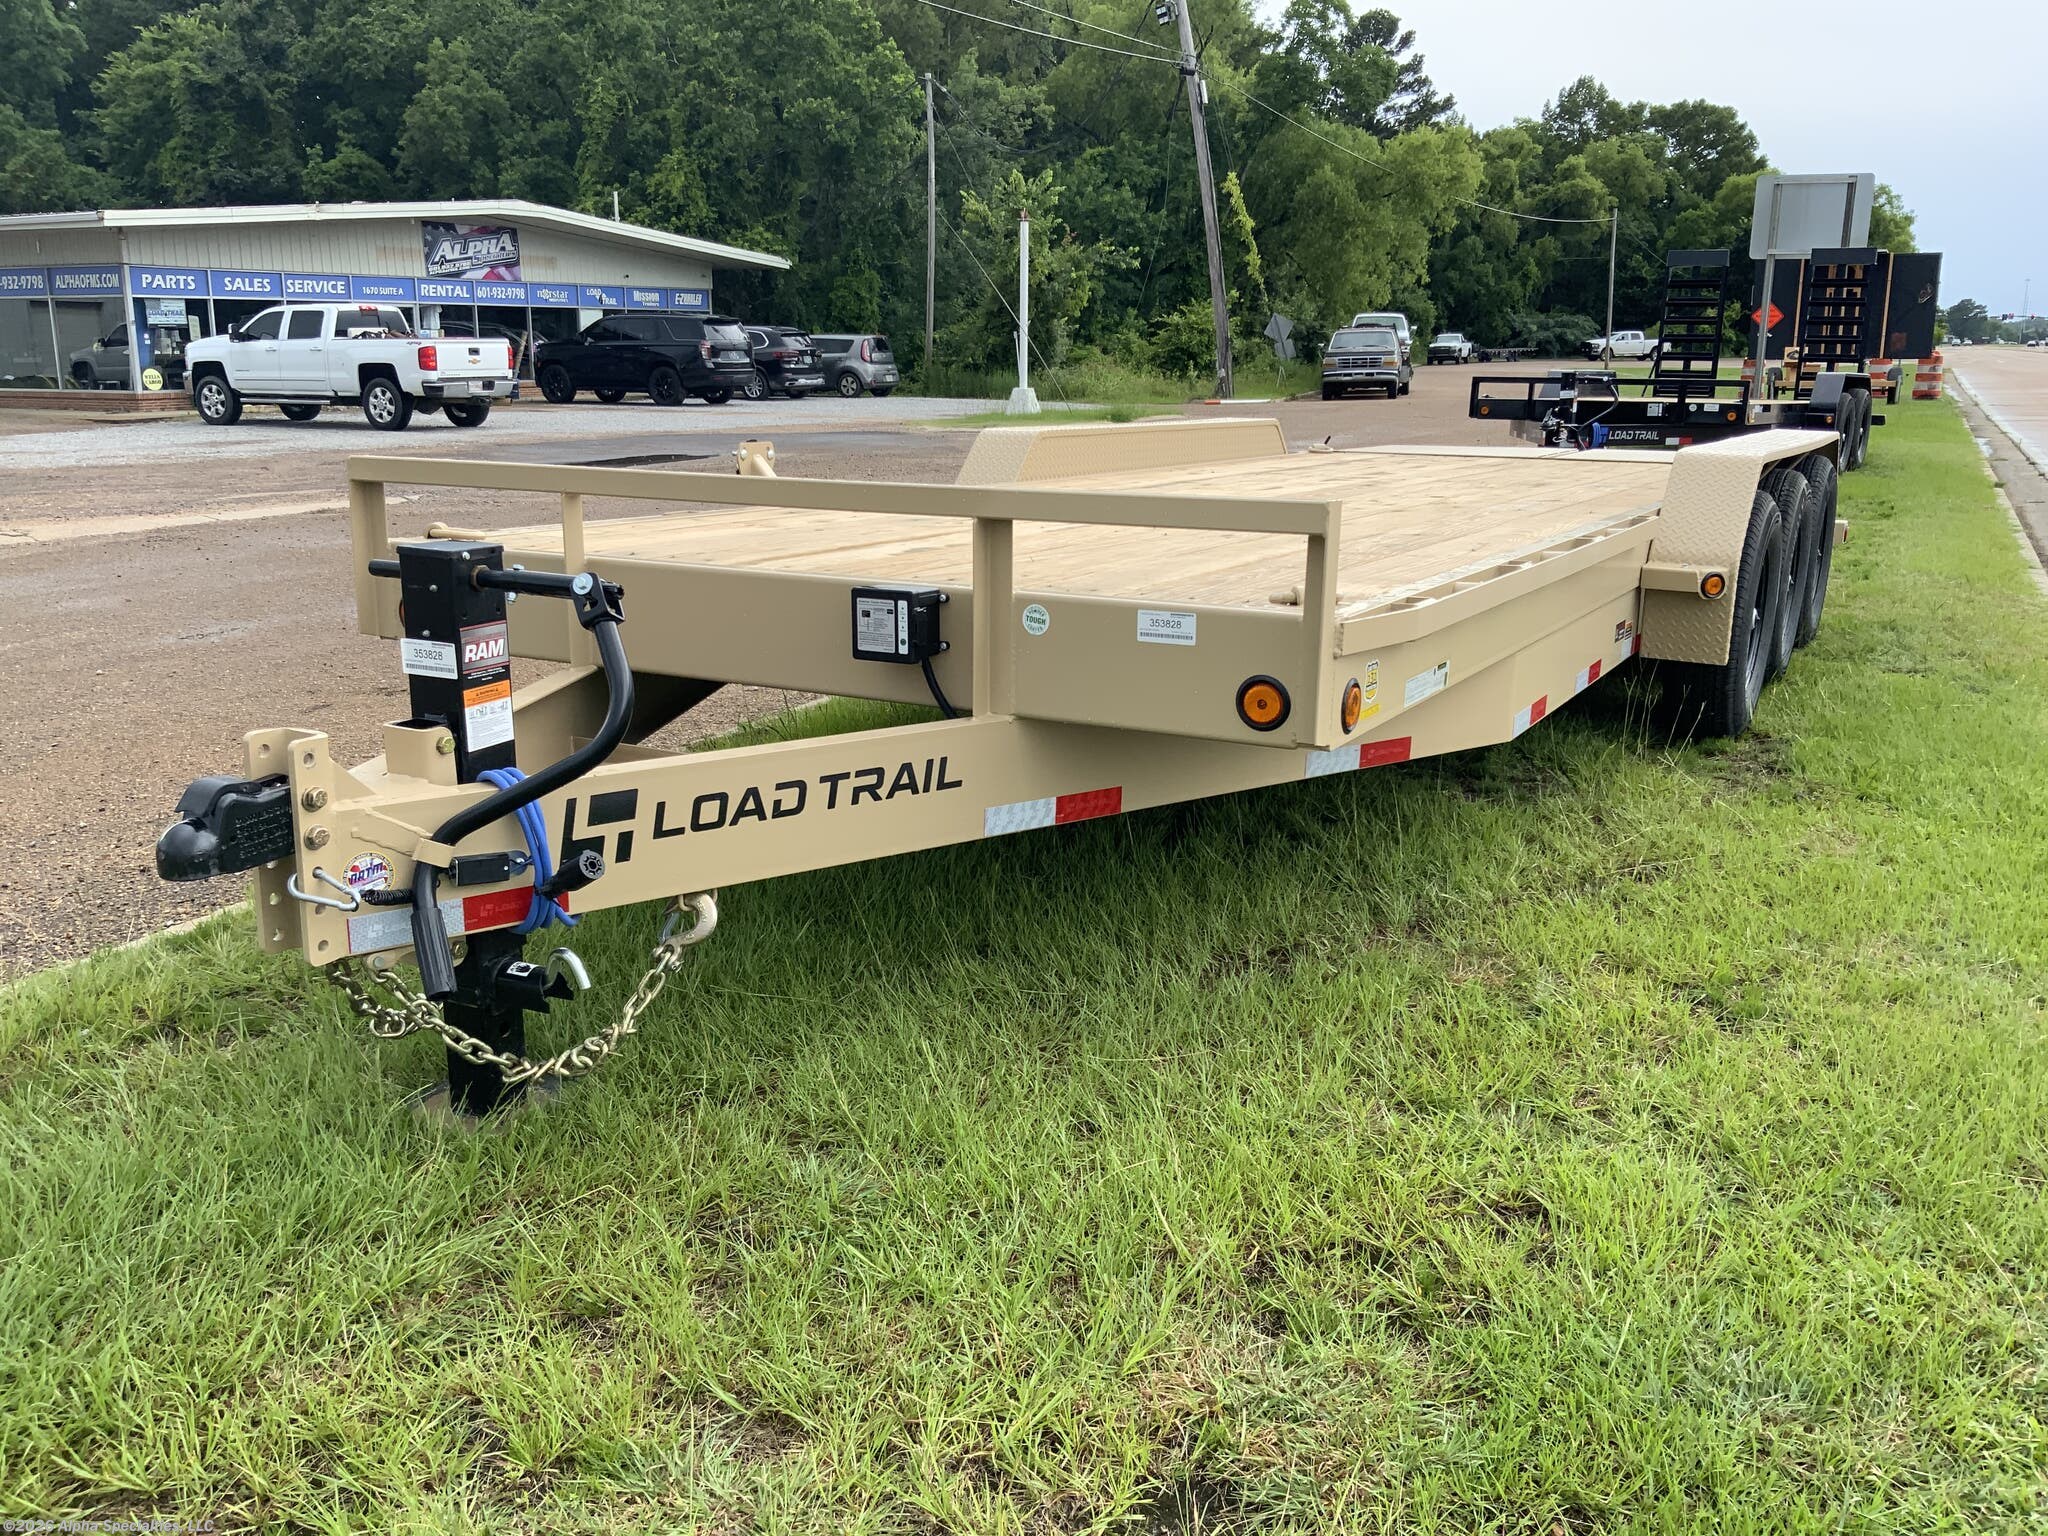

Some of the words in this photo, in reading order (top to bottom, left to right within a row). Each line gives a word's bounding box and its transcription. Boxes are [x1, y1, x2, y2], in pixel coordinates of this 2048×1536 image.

[431, 232, 516, 262] ALPHA
[55, 273, 120, 289] ALPHAOFMS.COM
[141, 273, 196, 290] PARTS
[224, 277, 271, 292] SALES
[286, 279, 346, 294] SERVICE
[362, 286, 379, 295] 1670
[379, 287, 399, 296] SUITE
[398, 287, 404, 296] A
[420, 284, 470, 298] RENTAL
[477, 286, 525, 300] 601-932-9798
[586, 288, 602, 296] LOAD
[603, 297, 618, 305] TRAIL
[1608, 430, 1634, 440] LOAD
[1635, 430, 1660, 440] TRAIL
[1149, 618, 1182, 629] 353828
[413, 648, 443, 661] 353828
[464, 638, 505, 663] RAM
[653, 779, 808, 840] LOAD
[819, 756, 963, 810] TRAIL
